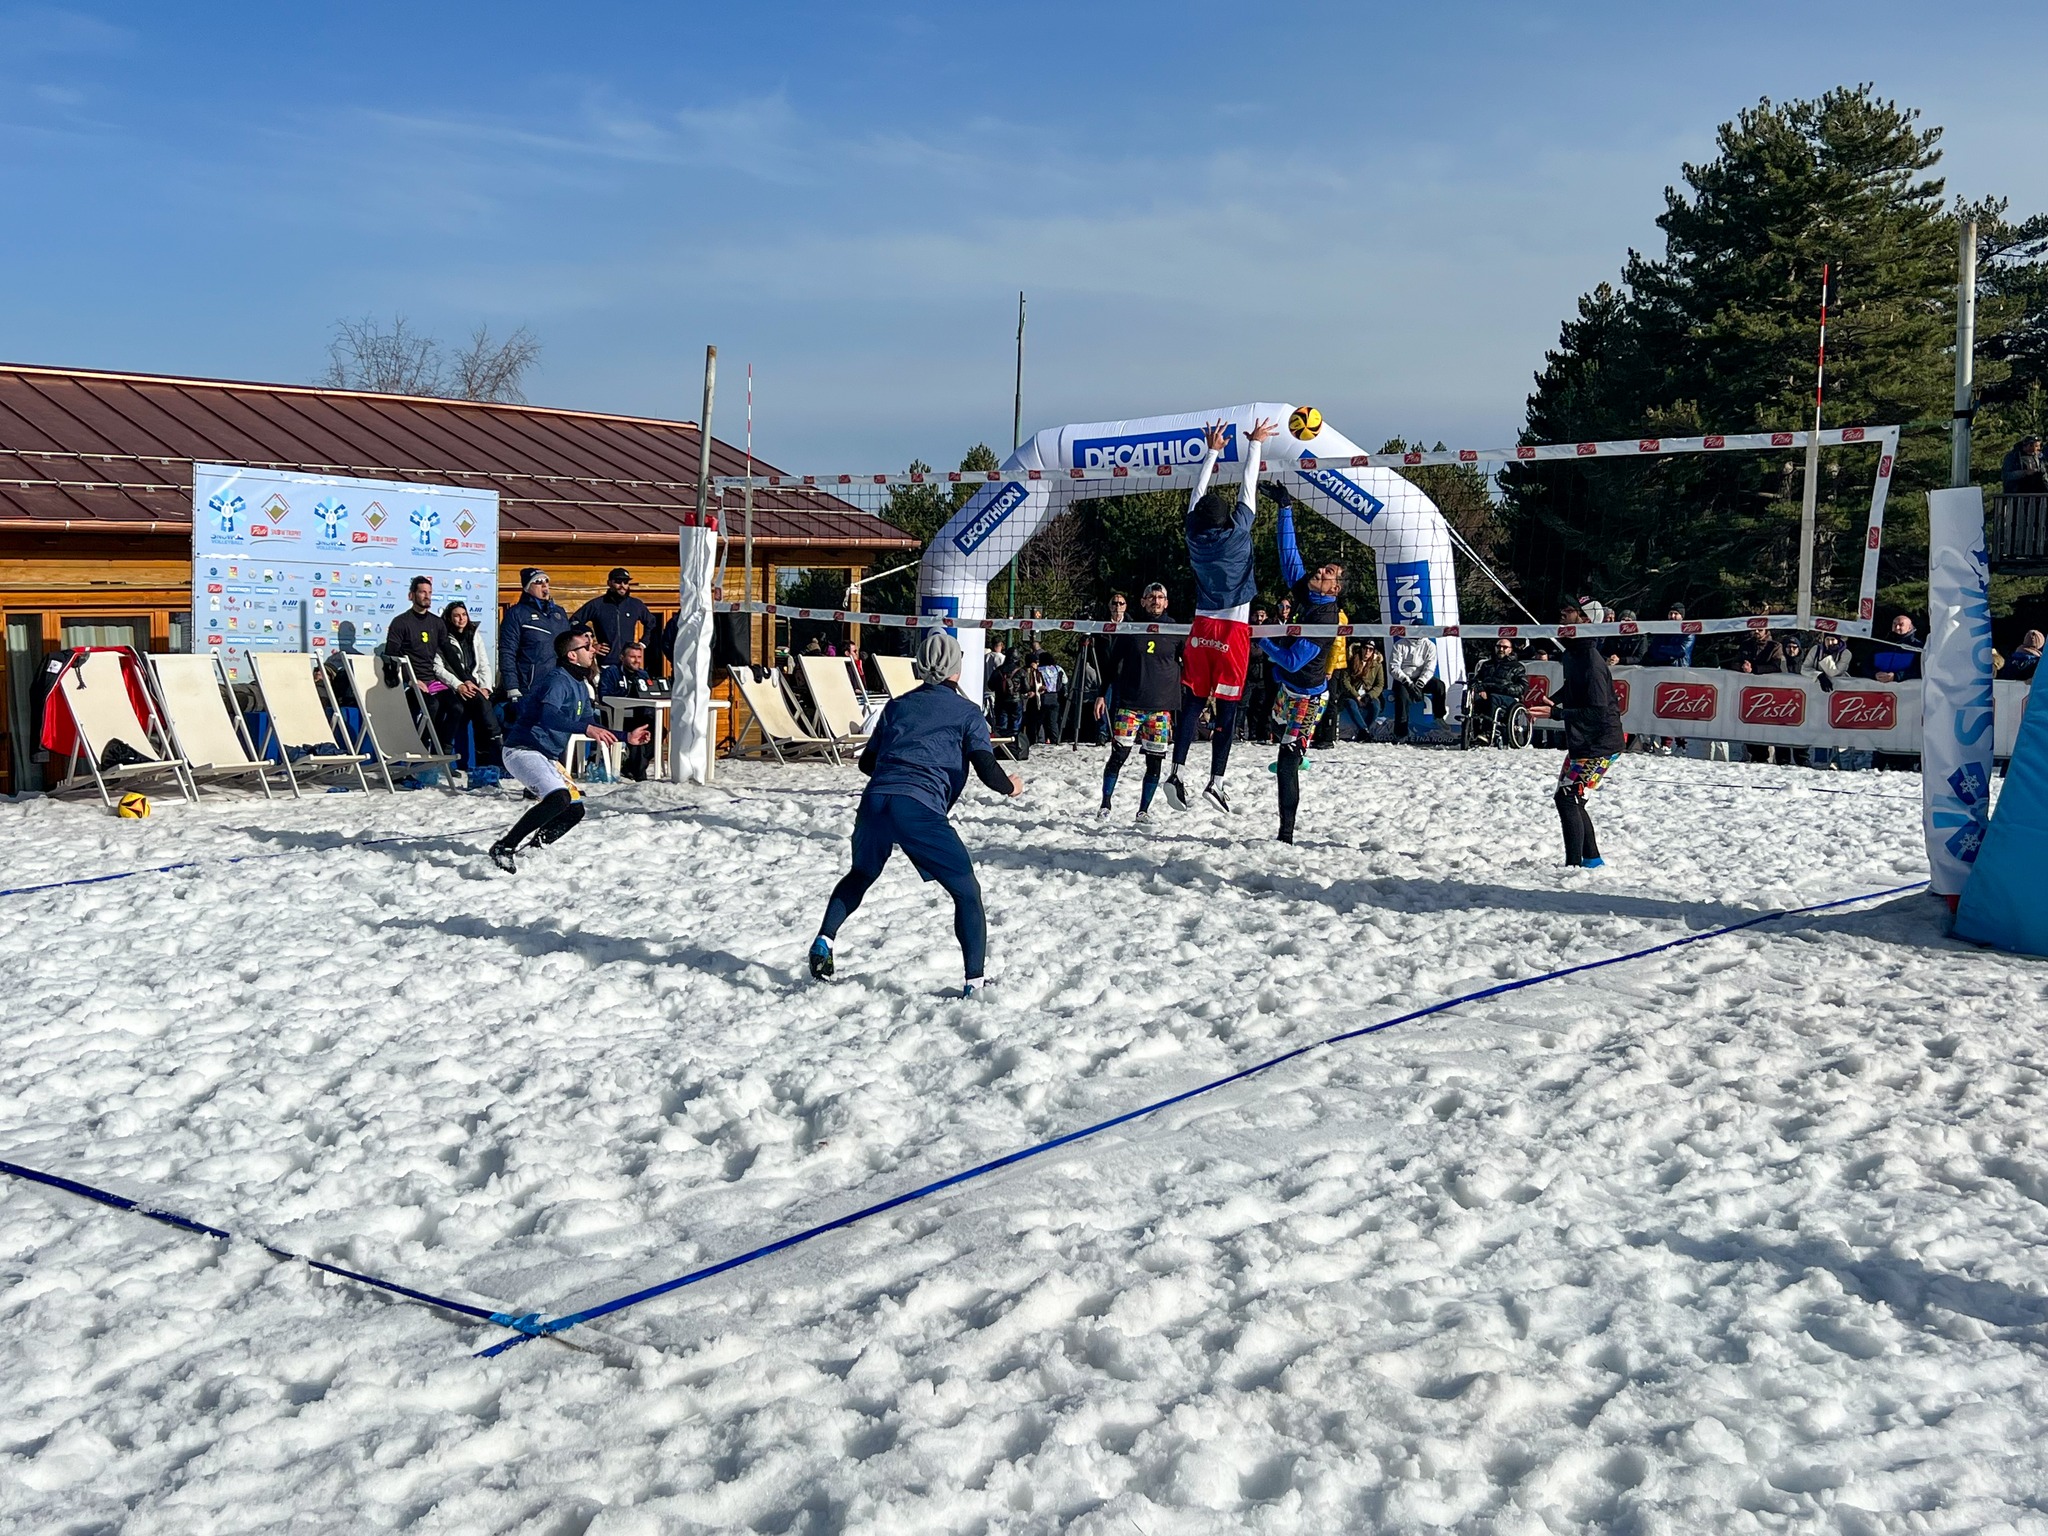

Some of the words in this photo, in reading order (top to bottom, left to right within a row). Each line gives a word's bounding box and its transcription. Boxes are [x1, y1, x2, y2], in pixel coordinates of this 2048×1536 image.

[1085, 437, 1225, 468] DECATHLO
[1304, 470, 1375, 516] ECATHLON
[960, 486, 1022, 549] DECATHLON
[421, 631, 429, 643] 3
[1147, 641, 1155, 653] 2
[1954, 587, 1994, 750] SNOW
[638, 679, 648, 691] 8
[658, 679, 669, 691] 7
